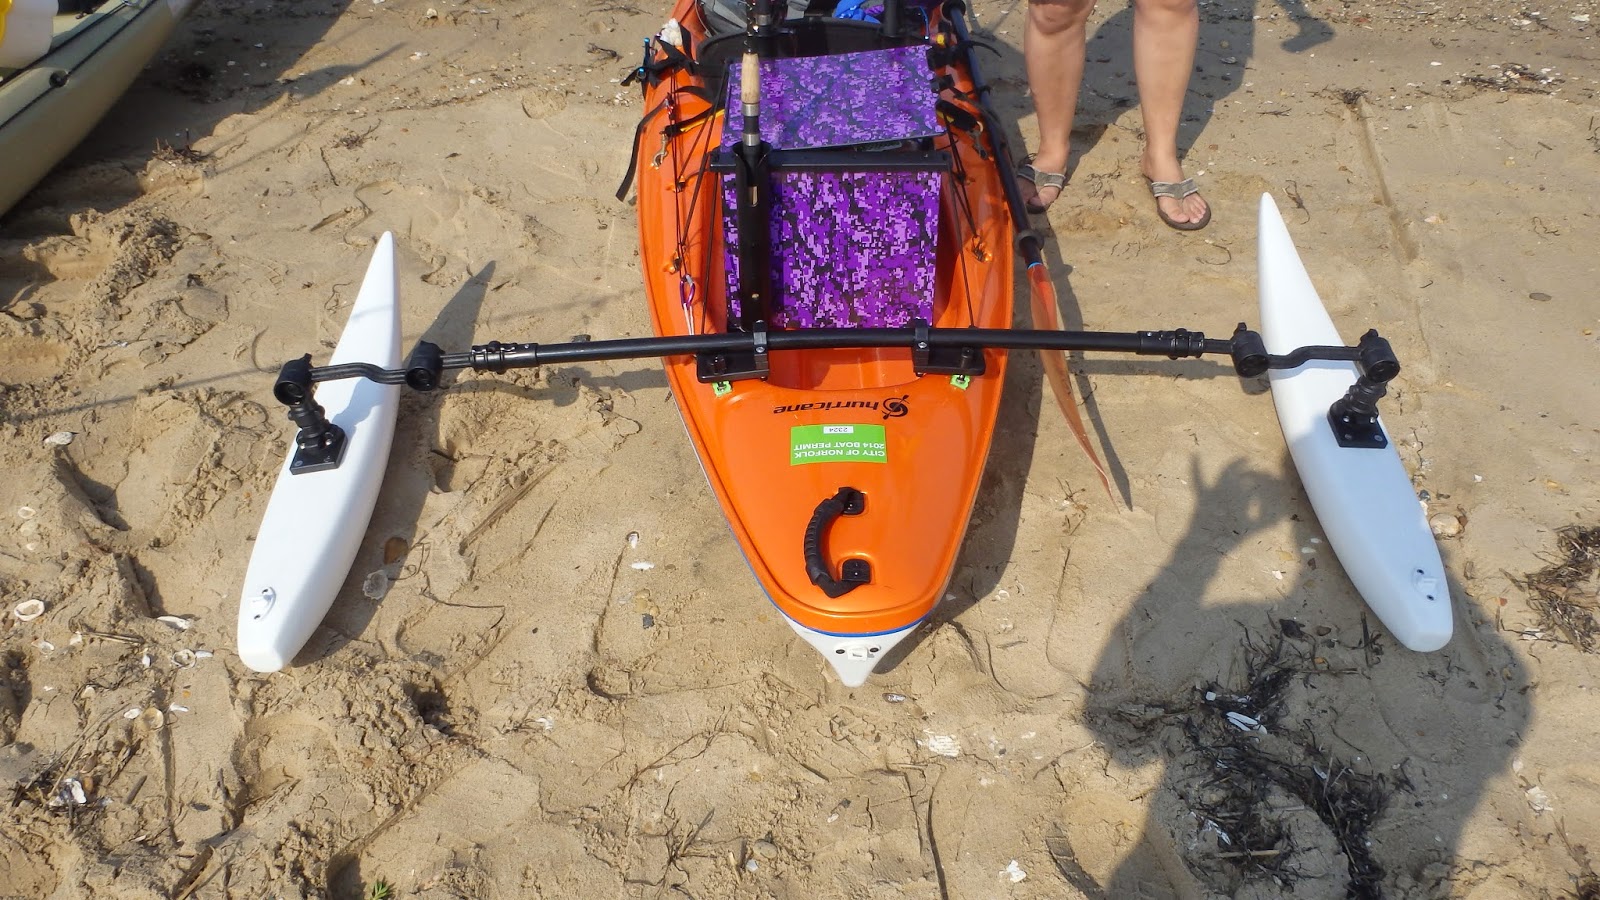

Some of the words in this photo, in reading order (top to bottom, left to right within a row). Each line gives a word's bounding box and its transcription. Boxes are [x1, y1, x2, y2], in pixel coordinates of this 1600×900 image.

[773, 400, 879, 414] hurricane
[793, 441, 831, 451] PERMIT
[794, 449, 843, 459] NORFOLK
[862, 449, 885, 457] CITY
